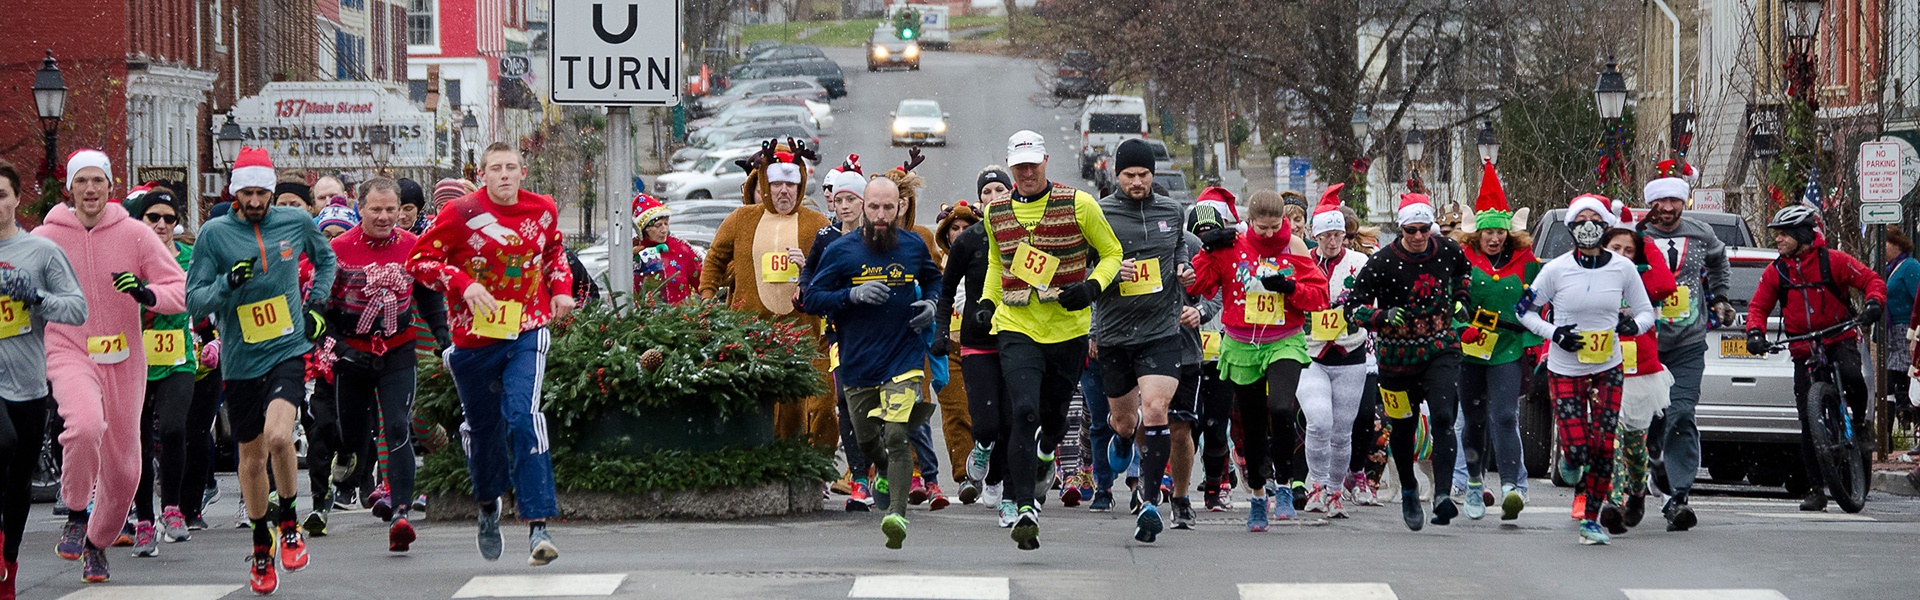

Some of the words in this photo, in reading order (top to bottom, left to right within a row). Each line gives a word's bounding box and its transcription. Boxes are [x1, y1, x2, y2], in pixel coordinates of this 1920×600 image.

[592, 4, 638, 44] U
[560, 56, 670, 90] TURN
[274, 99, 306, 117] 137
[305, 103, 335, 114] Main
[336, 101, 373, 114] Street
[244, 126, 320, 140] ASEBALL
[324, 125, 421, 140] SOUVIRS
[308, 142, 334, 156] ICE
[338, 142, 396, 156] CRE
[1866, 160, 1896, 168] PARKING
[771, 255, 788, 271] 69
[1024, 250, 1047, 275] 53
[0, 299, 14, 322] 5
[1257, 294, 1275, 313] 63
[252, 303, 277, 327] 60
[1321, 312, 1338, 329] 42
[154, 333, 174, 353] 33
[1202, 334, 1211, 350] 7
[1590, 333, 1609, 352] 37
[1383, 392, 1399, 409] 43
